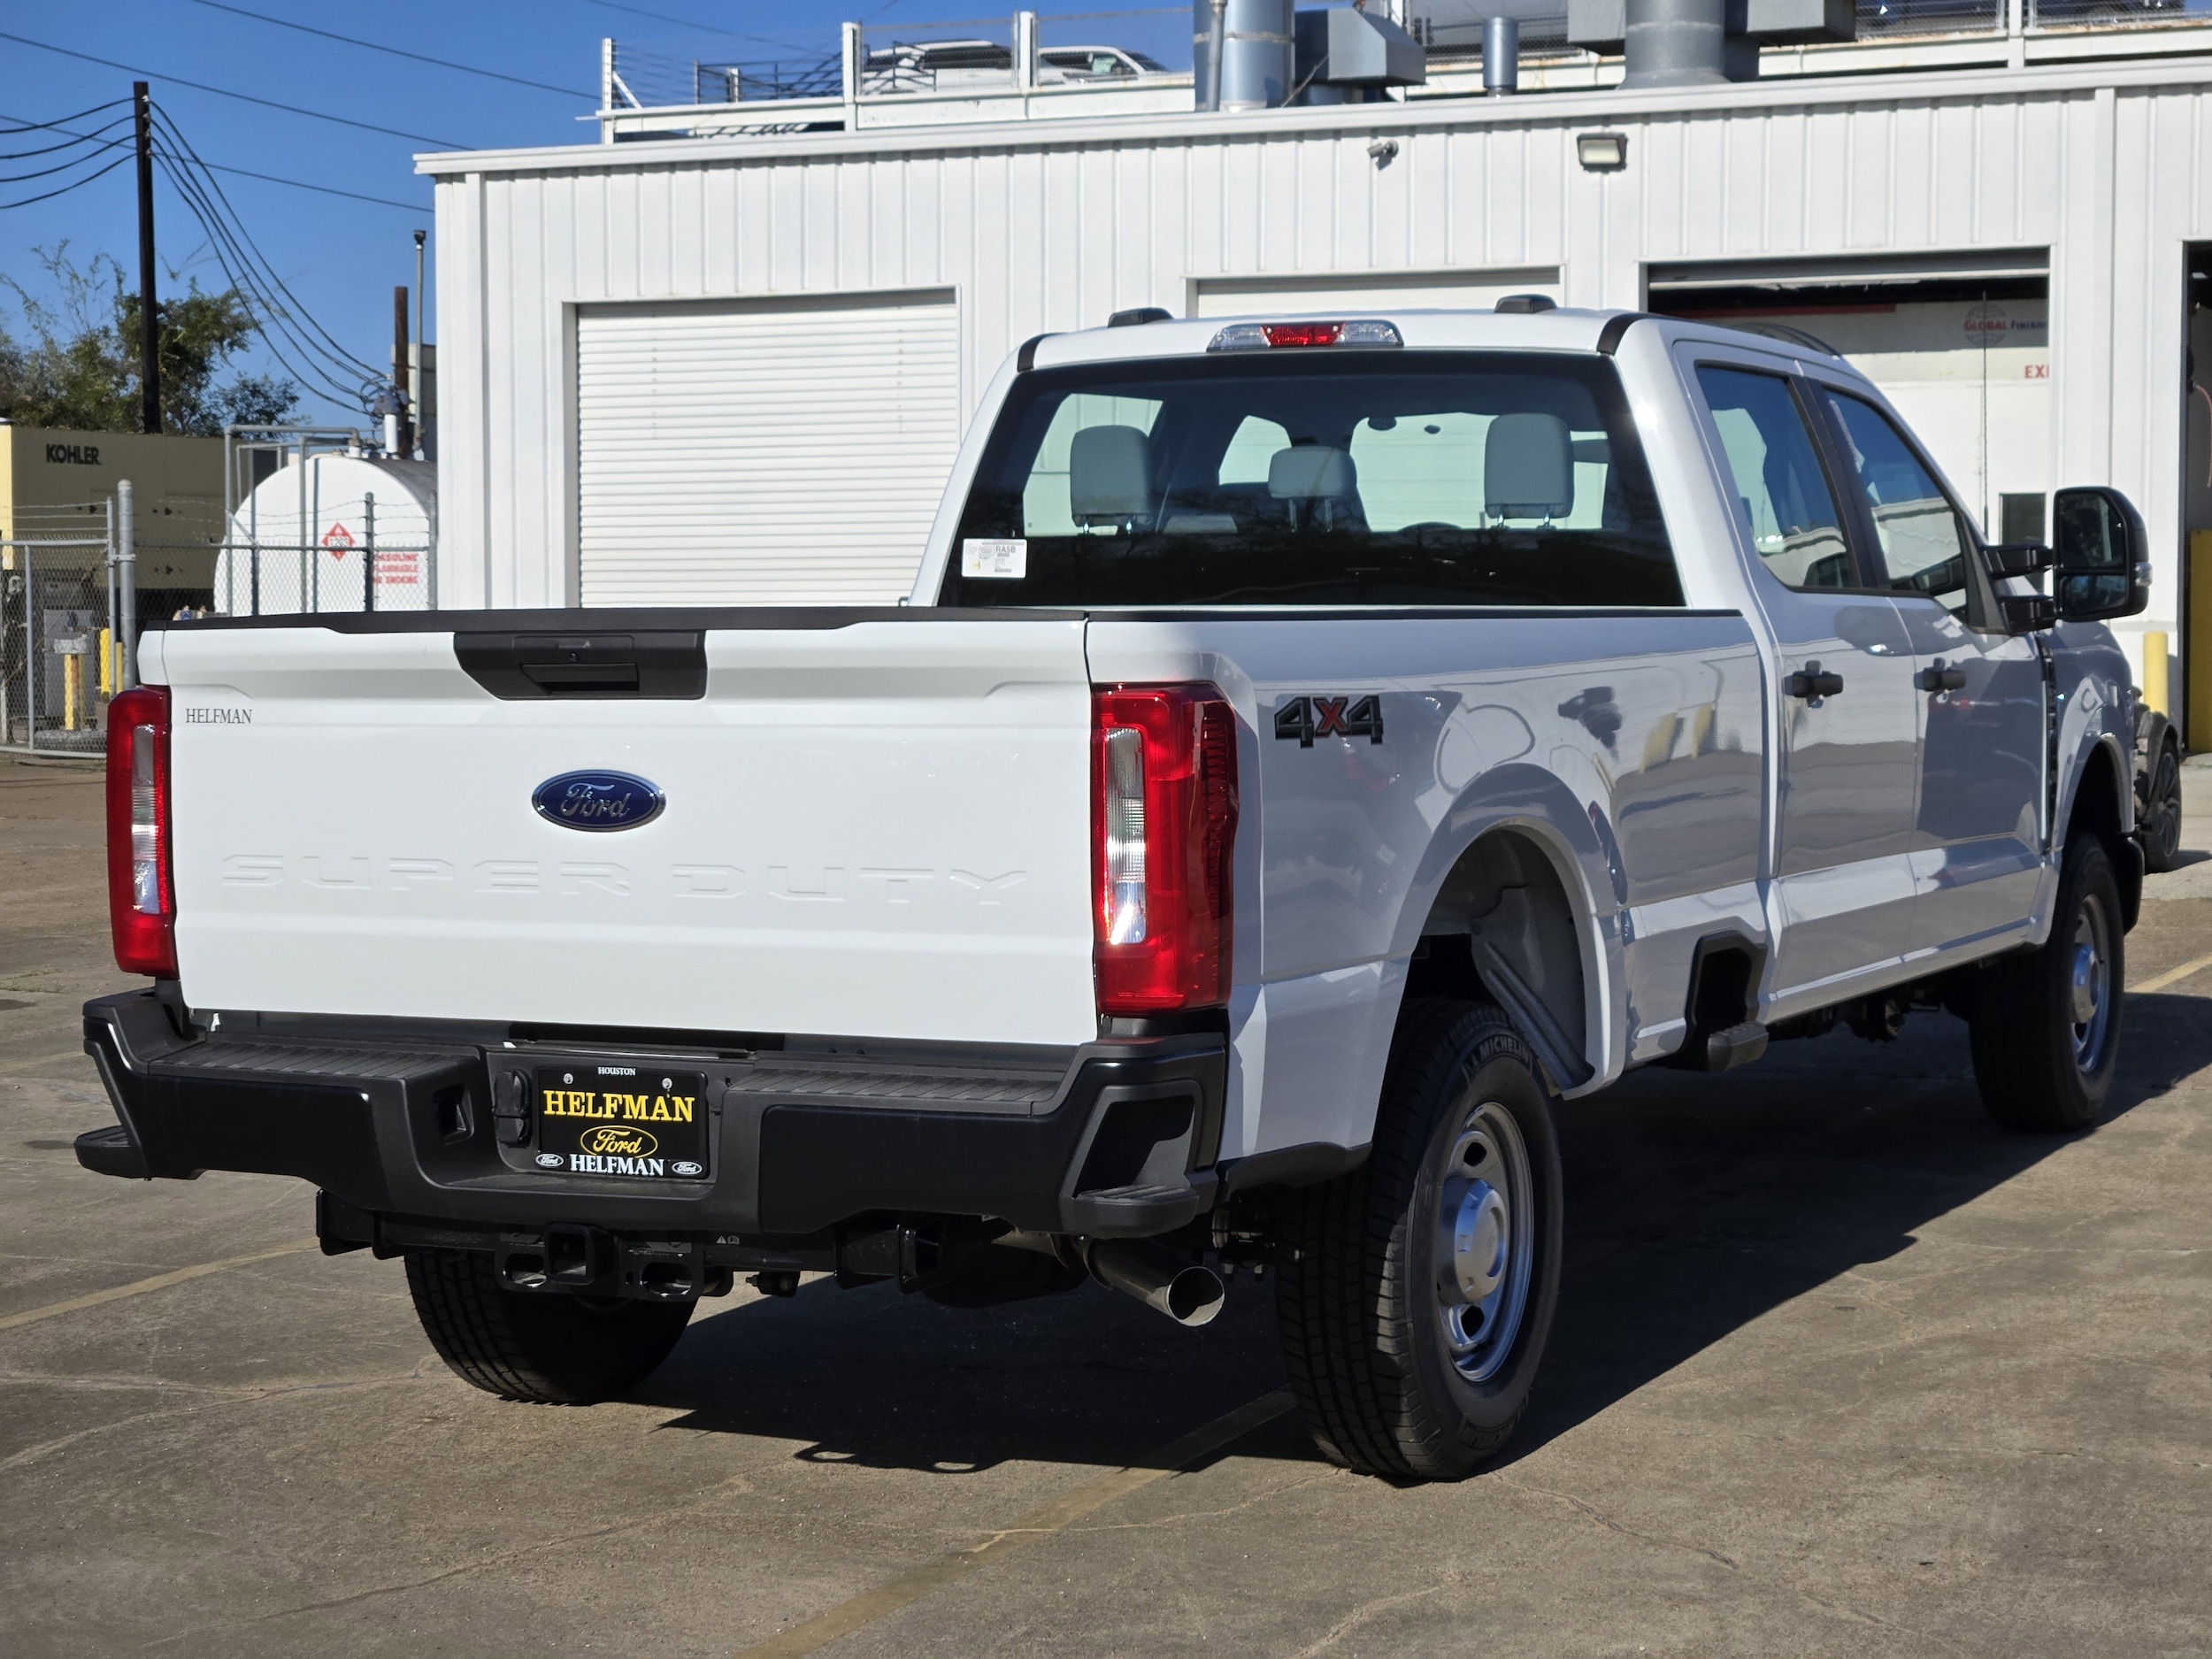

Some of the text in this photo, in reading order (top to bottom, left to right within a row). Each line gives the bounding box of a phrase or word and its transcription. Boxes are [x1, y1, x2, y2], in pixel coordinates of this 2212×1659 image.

[1964, 319, 2007, 330] GLOBAL
[46, 443, 101, 465] KOHLER
[186, 708, 252, 725] HELFMAN
[1274, 695, 1383, 749] 4X4
[560, 782, 632, 818] Ford
[221, 854, 1026, 904] SUPER DUTY
[1479, 1035, 1530, 1064] MICHELIN
[597, 1066, 636, 1077] HOUSTON
[542, 1089, 695, 1123] HELFMAN
[592, 1128, 643, 1156] Ford
[540, 1155, 559, 1165] Ford
[569, 1153, 664, 1177] HELFMAN
[677, 1163, 697, 1173] Ford
